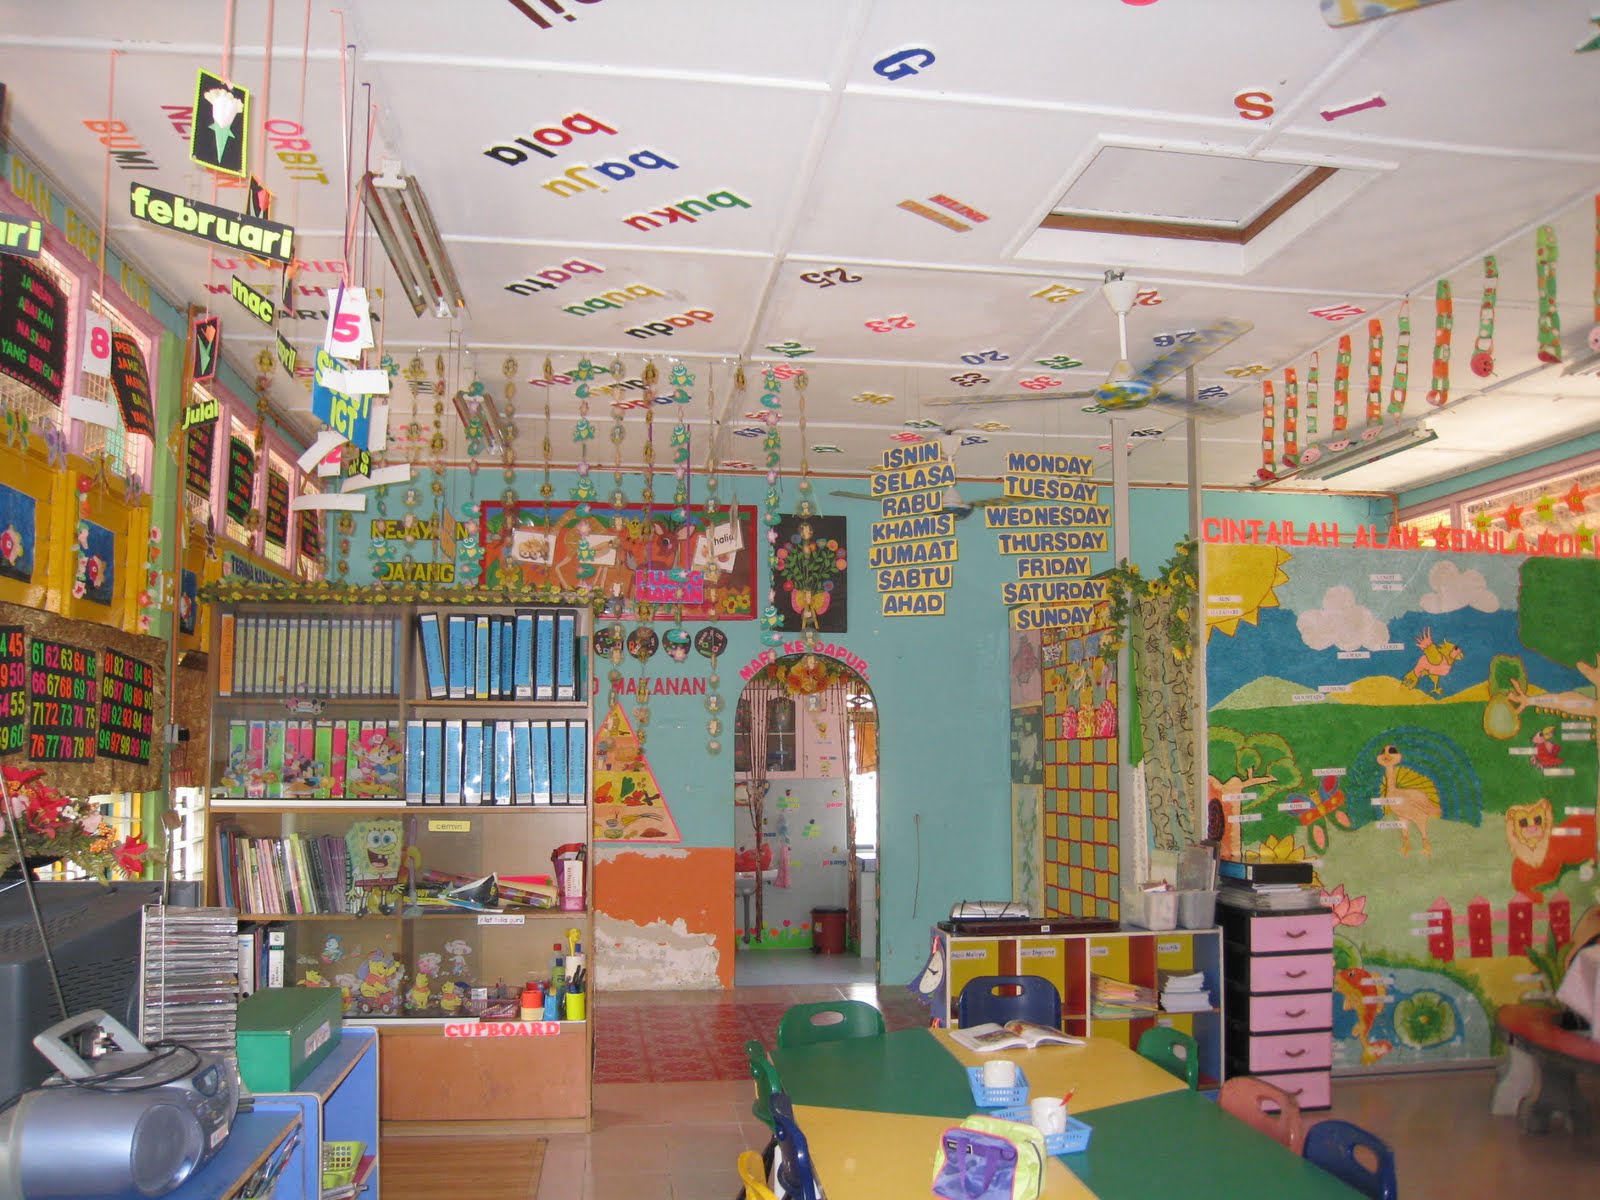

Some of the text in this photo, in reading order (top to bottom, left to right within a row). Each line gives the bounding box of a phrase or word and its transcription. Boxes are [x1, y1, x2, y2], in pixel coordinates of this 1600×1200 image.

[1234, 92, 1274, 120] S
[82, 120, 158, 170] BUMI
[264, 119, 329, 185] ORBIT
[483, 113, 618, 166] bola
[542, 150, 679, 197] baju
[131, 187, 293, 257] februari
[622, 191, 752, 231] buku
[504, 260, 604, 296] batu
[800, 268, 862, 288] 25
[232, 278, 274, 323] mac
[1133, 290, 1162, 306] 2
[332, 313, 361, 342] 5
[625, 309, 714, 338] dadu
[864, 316, 916, 332] 23
[1, 338, 27, 363] YANG
[91, 327, 110, 359] 8
[960, 350, 1009, 365] 20
[1019, 376, 1062, 390] 39
[182, 399, 218, 430] julai
[331, 396, 358, 440] ICT
[884, 443, 939, 468] ISNIN
[1008, 453, 1092, 474] MONDAY
[873, 465, 955, 494] SELASA
[1005, 476, 1097, 501] TUESDAY
[883, 492, 941, 517] RABU
[987, 507, 1109, 526] WEDNESDAY
[873, 515, 951, 542] KHAMIS
[1202, 518, 1339, 547] CINTAILAH
[1355, 524, 1419, 550] ALAM
[871, 540, 955, 566] JUMAAT
[999, 532, 1105, 552] THURSDAY
[878, 567, 950, 590] SABTU
[1018, 557, 1088, 577] FRIDAY
[884, 595, 943, 614] AHAD
[1004, 581, 1104, 603] SATURDAY
[1017, 606, 1093, 629] SUNDAY
[0, 633, 23, 657] 4 45
[784, 641, 806, 655] KE
[32, 642, 96, 679] 61 62 63 64 65
[104, 652, 152, 686] 81 82 83 84 85
[0, 663, 24, 688] 9 50
[32, 672, 96, 703] 66 67 68 69 70
[11, 691, 25, 716] 55
[103, 676, 152, 709] 86 87 88 89 90
[33, 702, 96, 729] 71 72 73 74 75
[101, 703, 152, 736] 91 92 93 94 95
[11, 724, 24, 747] 60
[31, 733, 96, 759] 76 77 78 79 80
[99, 728, 150, 759] 96 97 98 99 100
[446, 1022, 559, 1037] CUPBOARD
